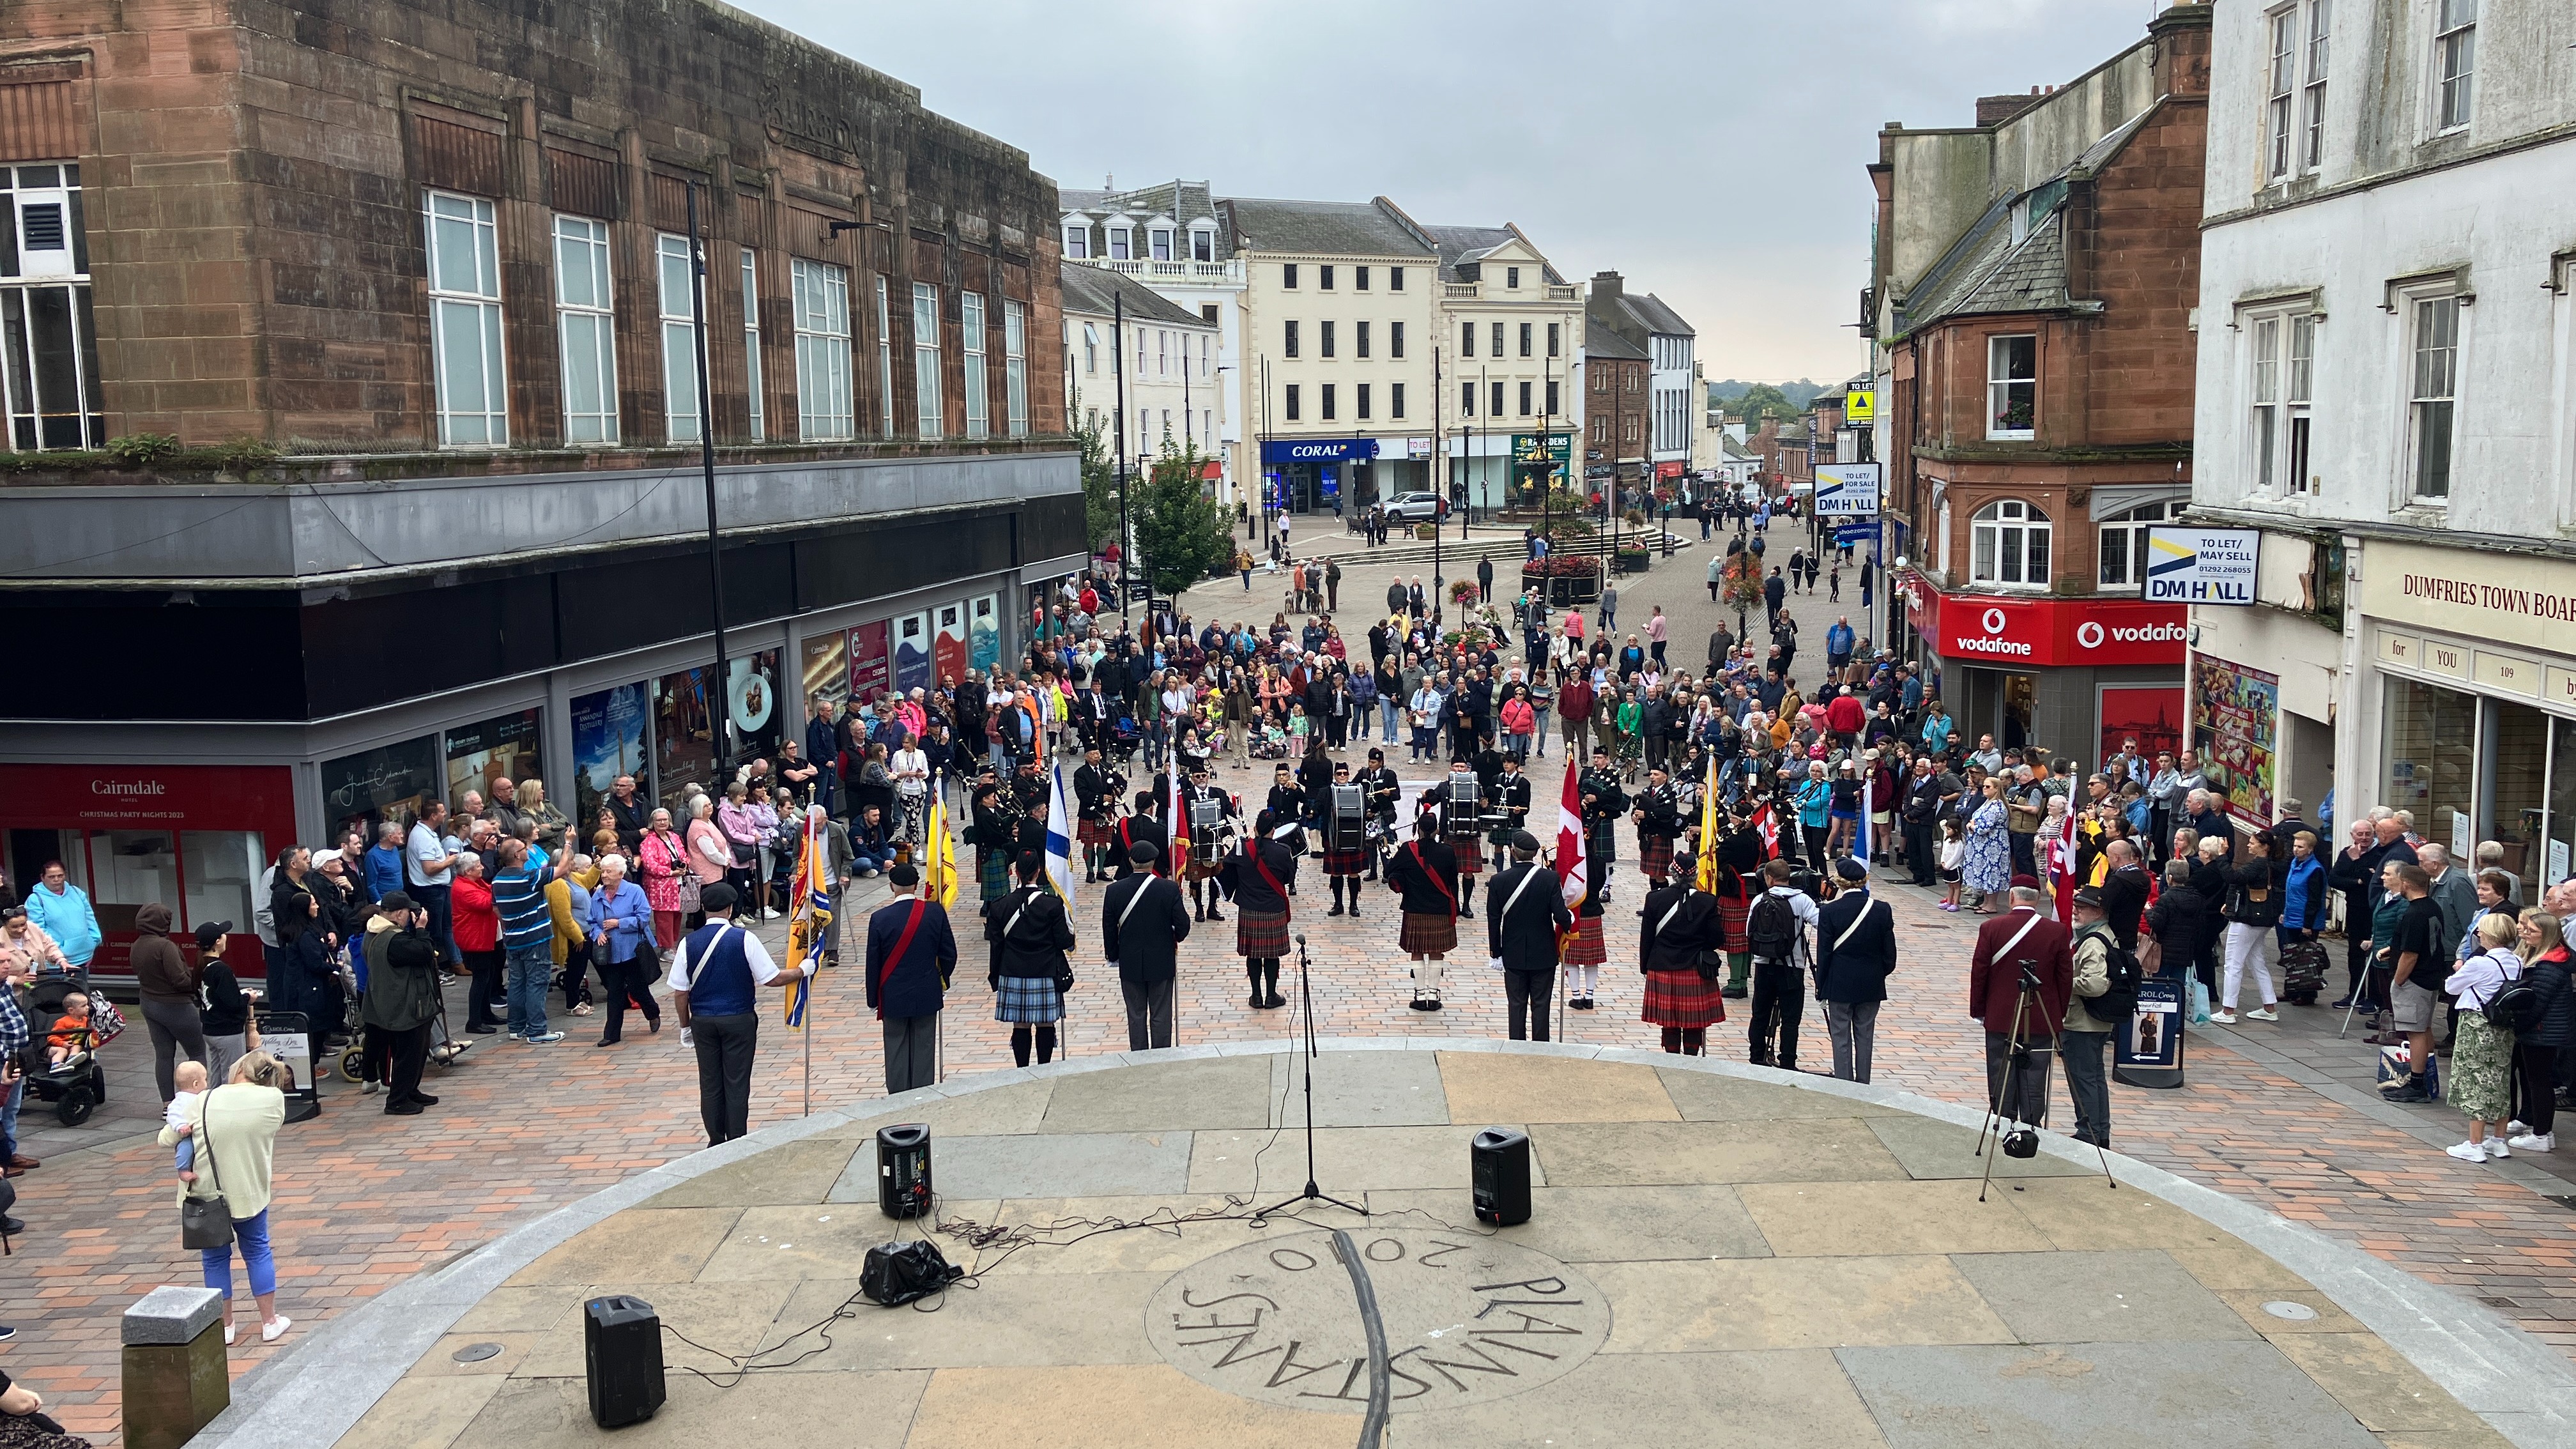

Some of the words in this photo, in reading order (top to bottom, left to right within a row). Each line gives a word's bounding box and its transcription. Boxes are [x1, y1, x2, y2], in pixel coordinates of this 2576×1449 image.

[1292, 445, 1340, 457] CORAL
[1819, 499, 1839, 510] DM
[1842, 499, 1874, 510] HALL
[2201, 539, 2215, 548] TO
[2218, 539, 2242, 549] LET/
[2200, 551, 2224, 560] MAY
[2226, 552, 2252, 561] SELL
[2152, 579, 2186, 598] DM
[2191, 581, 2249, 601] HALL
[2404, 574, 2477, 606] DUMFRIES
[2481, 585, 2529, 615] TOWN
[1957, 636, 2031, 656] vodafone
[2393, 640, 2406, 657] for
[2437, 649, 2457, 668] YOU
[2501, 666, 2514, 678] 109
[579, 719, 602, 731] DISTILLERY
[91, 780, 165, 794] Cairndale
